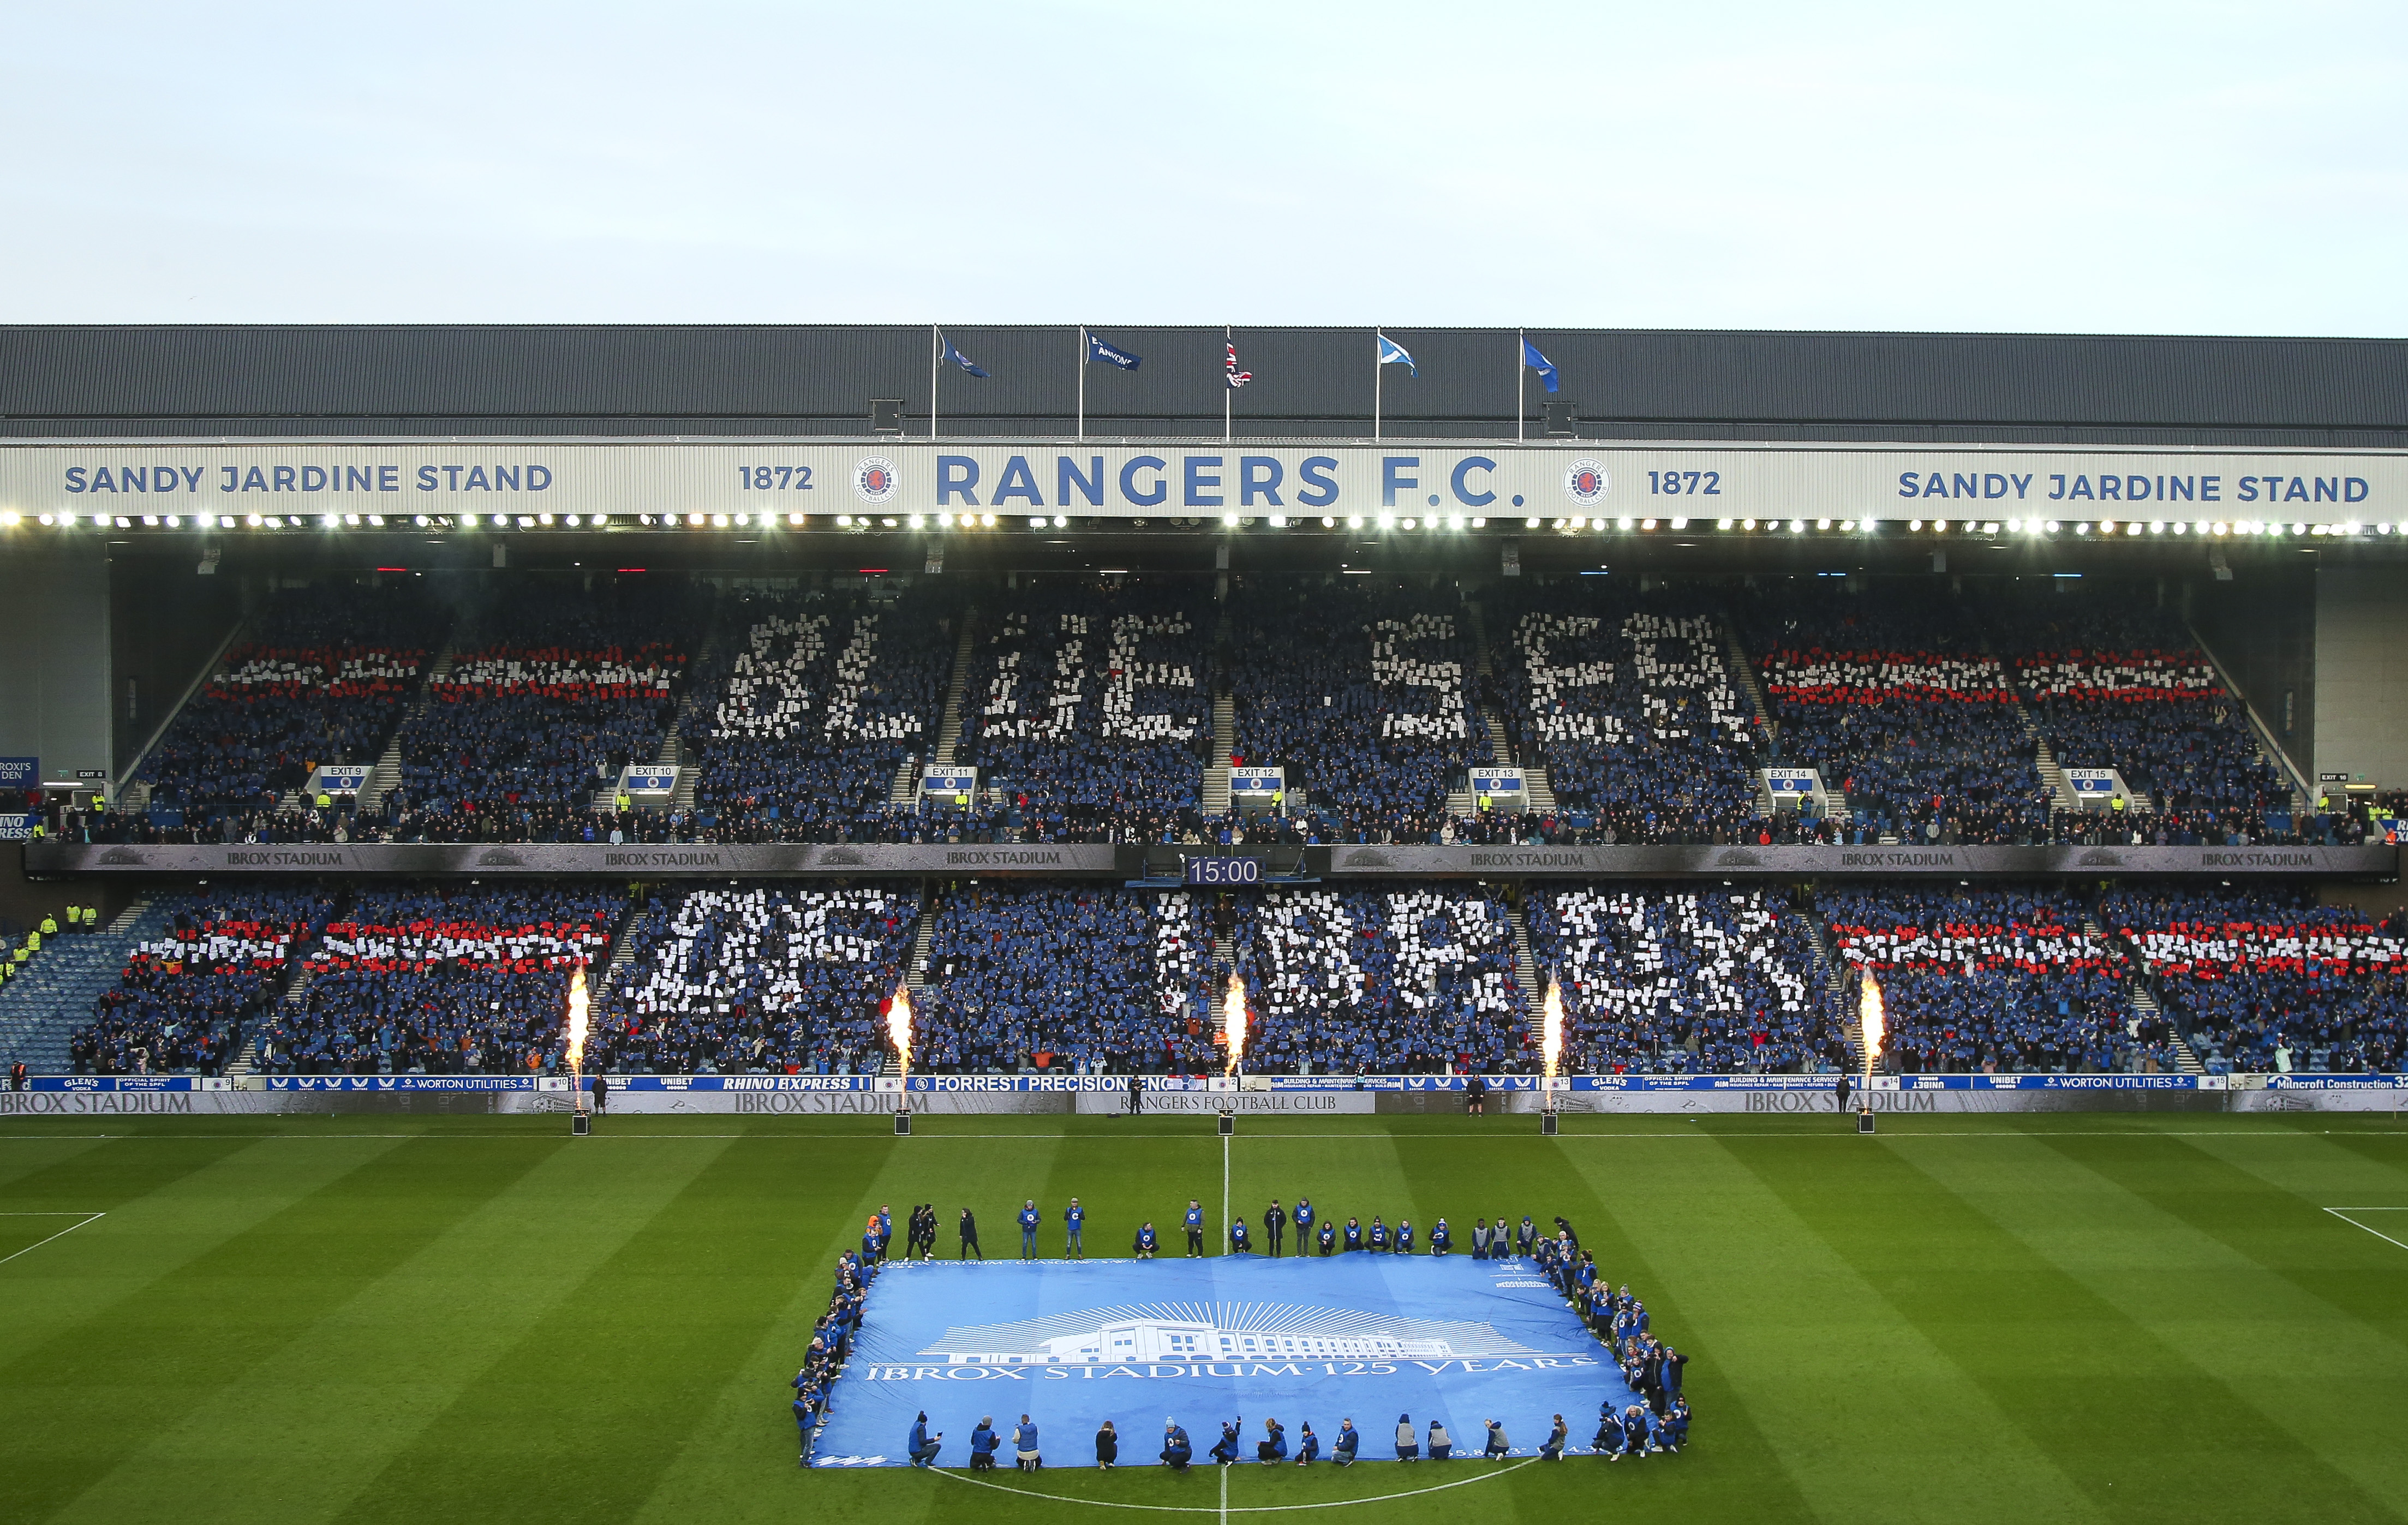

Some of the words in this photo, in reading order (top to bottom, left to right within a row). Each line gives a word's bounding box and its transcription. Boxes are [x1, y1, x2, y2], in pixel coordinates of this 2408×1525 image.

[858, 459, 895, 471] RANGERS
[1569, 461, 1605, 474] RANGERS
[64, 466, 205, 493] SANDY
[219, 465, 400, 492] JARDINE
[416, 464, 552, 492] STAND
[739, 467, 813, 489] 1872
[936, 456, 1339, 507] RANGERS
[1384, 456, 1524, 507] F.C.
[1648, 471, 1720, 495] 1872
[856, 485, 885, 501] FOOTBALL
[885, 484, 897, 498] CLUB
[1898, 472, 2034, 499] SANDY
[2048, 474, 2221, 501] JARDINE
[2238, 476, 2369, 502] STAND
[1567, 487, 1596, 504] FOOTBALL
[1595, 487, 1607, 500] CLUB
[636, 767, 658, 775] EXIT
[933, 768, 955, 776] EXIT
[958, 768, 968, 776] 11
[1771, 770, 1794, 778] EXIT
[1796, 770, 1807, 778] 14
[2071, 770, 2093, 778] EXIT
[2095, 770, 2106, 778] 15
[228, 853, 270, 865] IBROX
[274, 852, 342, 865] STADIUM
[606, 853, 648, 865] IBROX
[652, 853, 719, 865] STADIUM
[947, 852, 989, 864] IBROX
[993, 852, 1060, 864] STADIUM
[1471, 853, 1513, 865] IBROX
[1516, 853, 1584, 865] STADIUM
[1842, 853, 1883, 865] IBROX
[1887, 853, 1953, 865] STADIUM
[2202, 854, 2242, 866] IBROX
[2247, 854, 2313, 866] STADIUM
[1191, 860, 1258, 882] 15:00
[64, 1078, 99, 1087] GLEN'S
[417, 1080, 464, 1089] WORTON
[466, 1080, 517, 1089] UTILITIES
[723, 1078, 775, 1090] RHINO
[777, 1078, 851, 1090] EXPRESS
[935, 1078, 1022, 1091] FORREST
[1029, 1077, 1128, 1091] PRECISION
[1591, 1077, 1628, 1086] GLEN'S
[1912, 1081, 1944, 1089] UNIBET
[2060, 1078, 2112, 1087] WORTON
[2116, 1078, 2172, 1088] UTILITIES
[2277, 1079, 2325, 1089] Milncroft
[2327, 1079, 2393, 1089] Construction
[75, 1093, 192, 1113] STADIUM
[736, 1093, 806, 1113] IBROX
[814, 1093, 930, 1113] STADIUM
[1204, 1096, 1289, 1110] FOOTBALL
[1294, 1096, 1336, 1110] CLUB
[1746, 1092, 1814, 1111] IBROX
[1823, 1092, 1936, 1111] SADIUM
[865, 1366, 1029, 1380] IBROX
[1045, 1363, 1304, 1379] STADIUM
[1322, 1361, 1397, 1376] 125
[1412, 1357, 1599, 1376] YEARS
